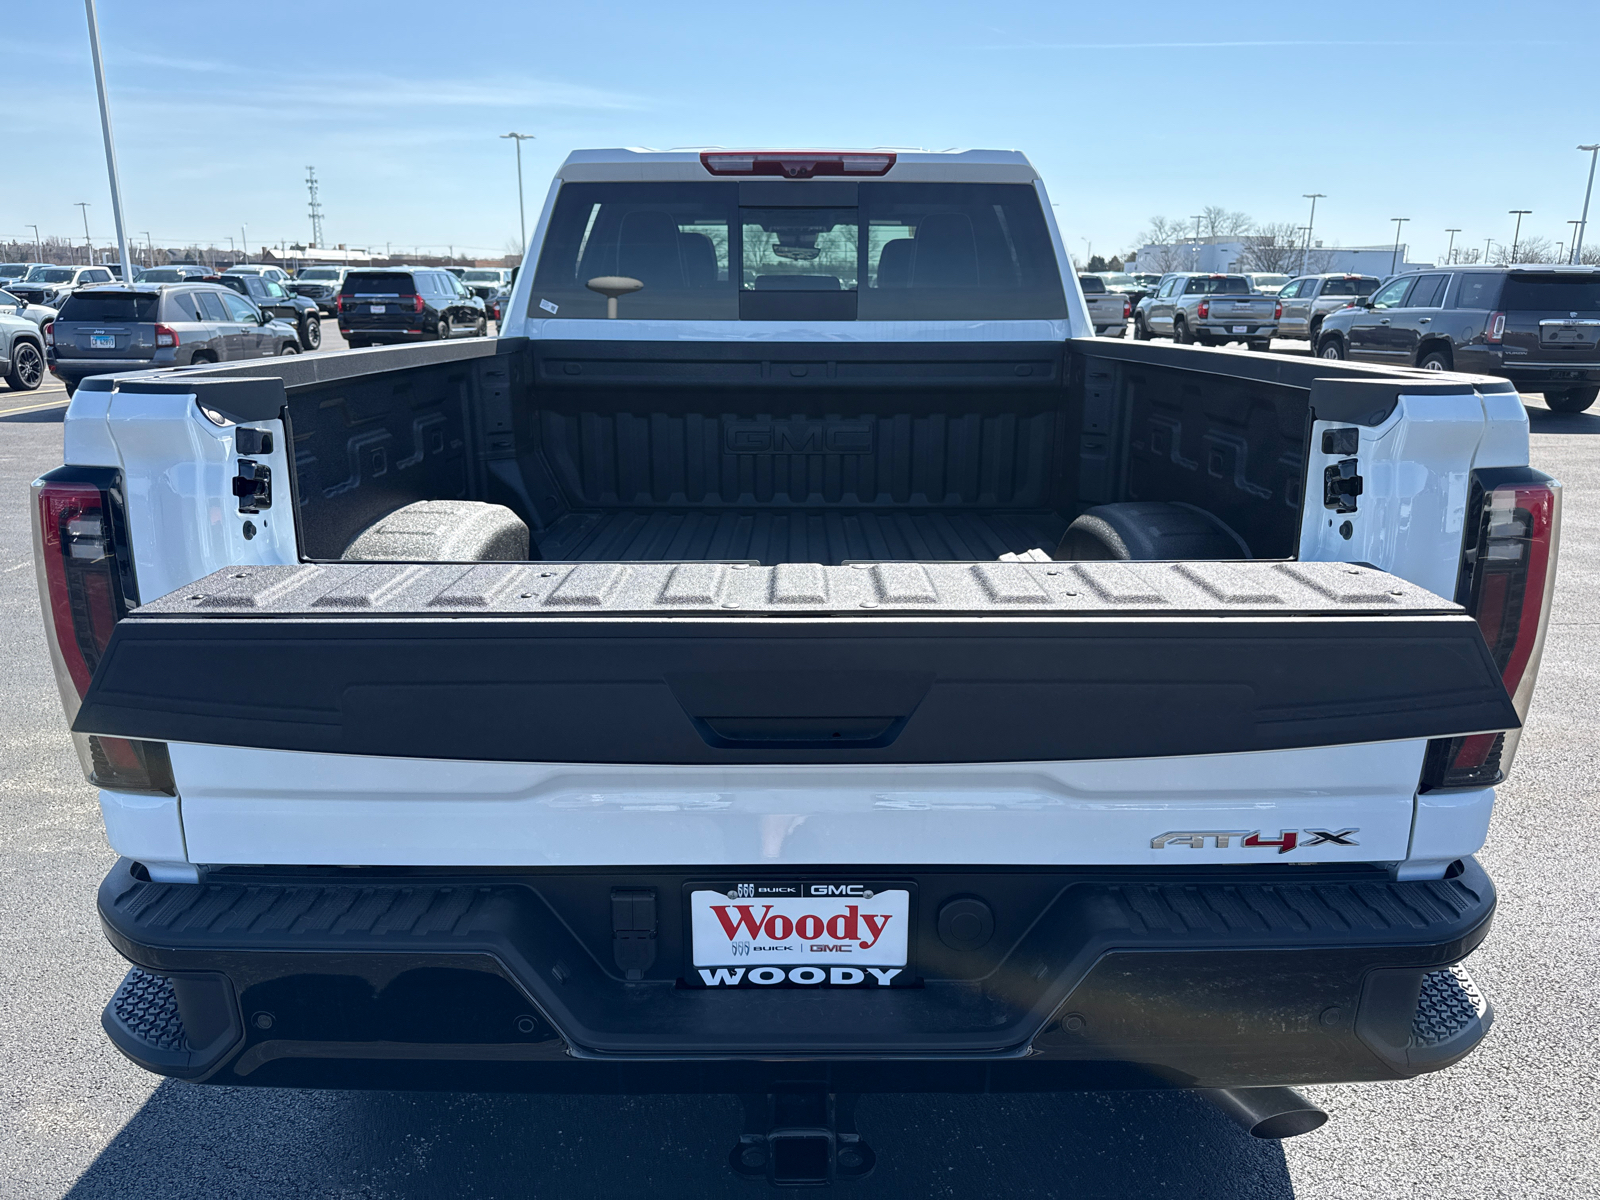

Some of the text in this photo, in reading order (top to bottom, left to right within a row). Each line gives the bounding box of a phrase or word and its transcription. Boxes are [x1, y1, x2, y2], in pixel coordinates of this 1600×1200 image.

[727, 425, 871, 451] GMC
[1151, 828, 1360, 854] AT4X
[810, 884, 864, 895] GMC
[709, 905, 893, 950] Woody
[809, 944, 853, 953] GMC
[697, 967, 903, 986] WOODY
